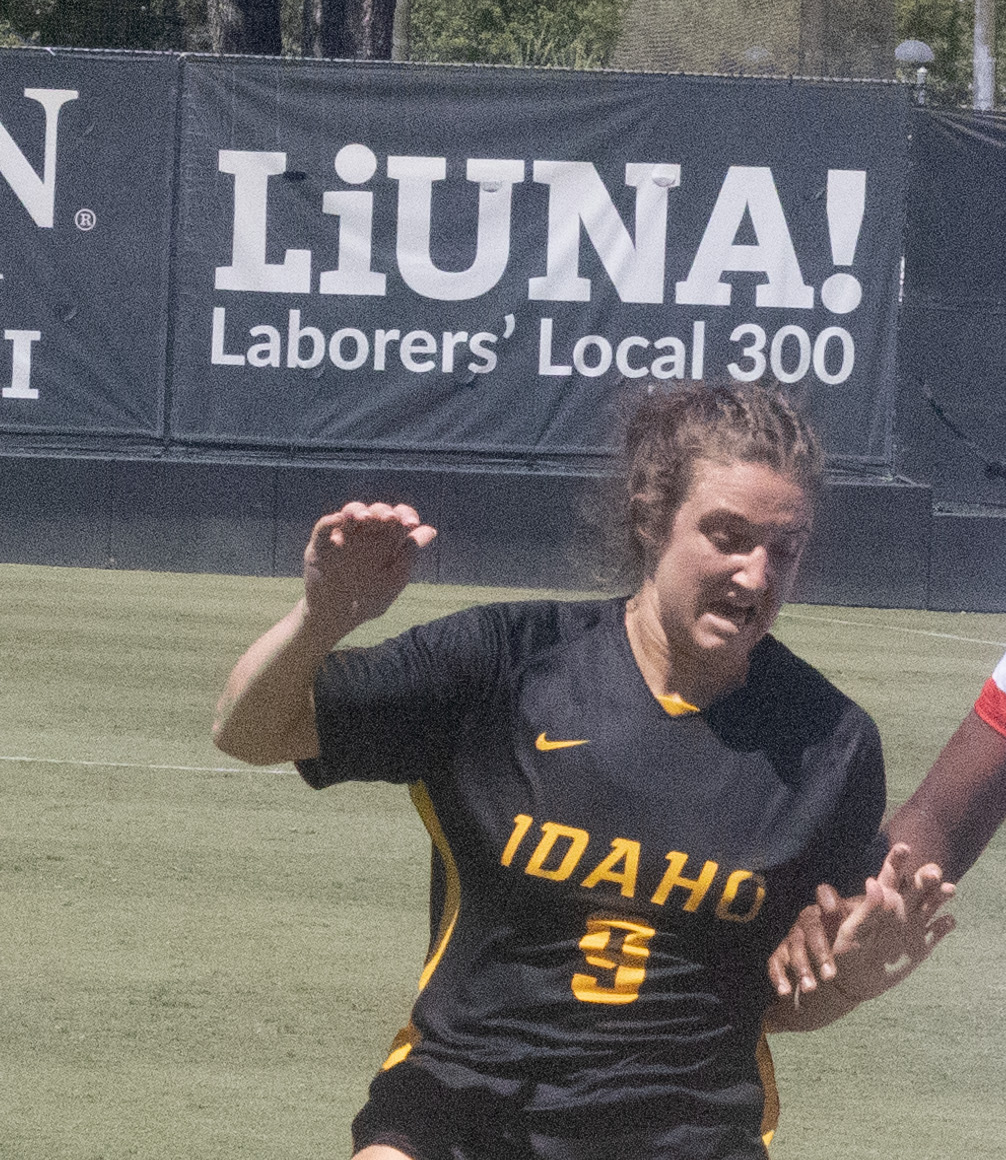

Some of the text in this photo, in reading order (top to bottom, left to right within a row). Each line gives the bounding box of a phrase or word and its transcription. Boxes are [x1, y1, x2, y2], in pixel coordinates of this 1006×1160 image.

[214, 143, 867, 315] LiUNA!
[210, 306, 855, 385] Laborers’ Local 300
[500, 813, 766, 924] IDAHO
[571, 915, 656, 1005] 9
